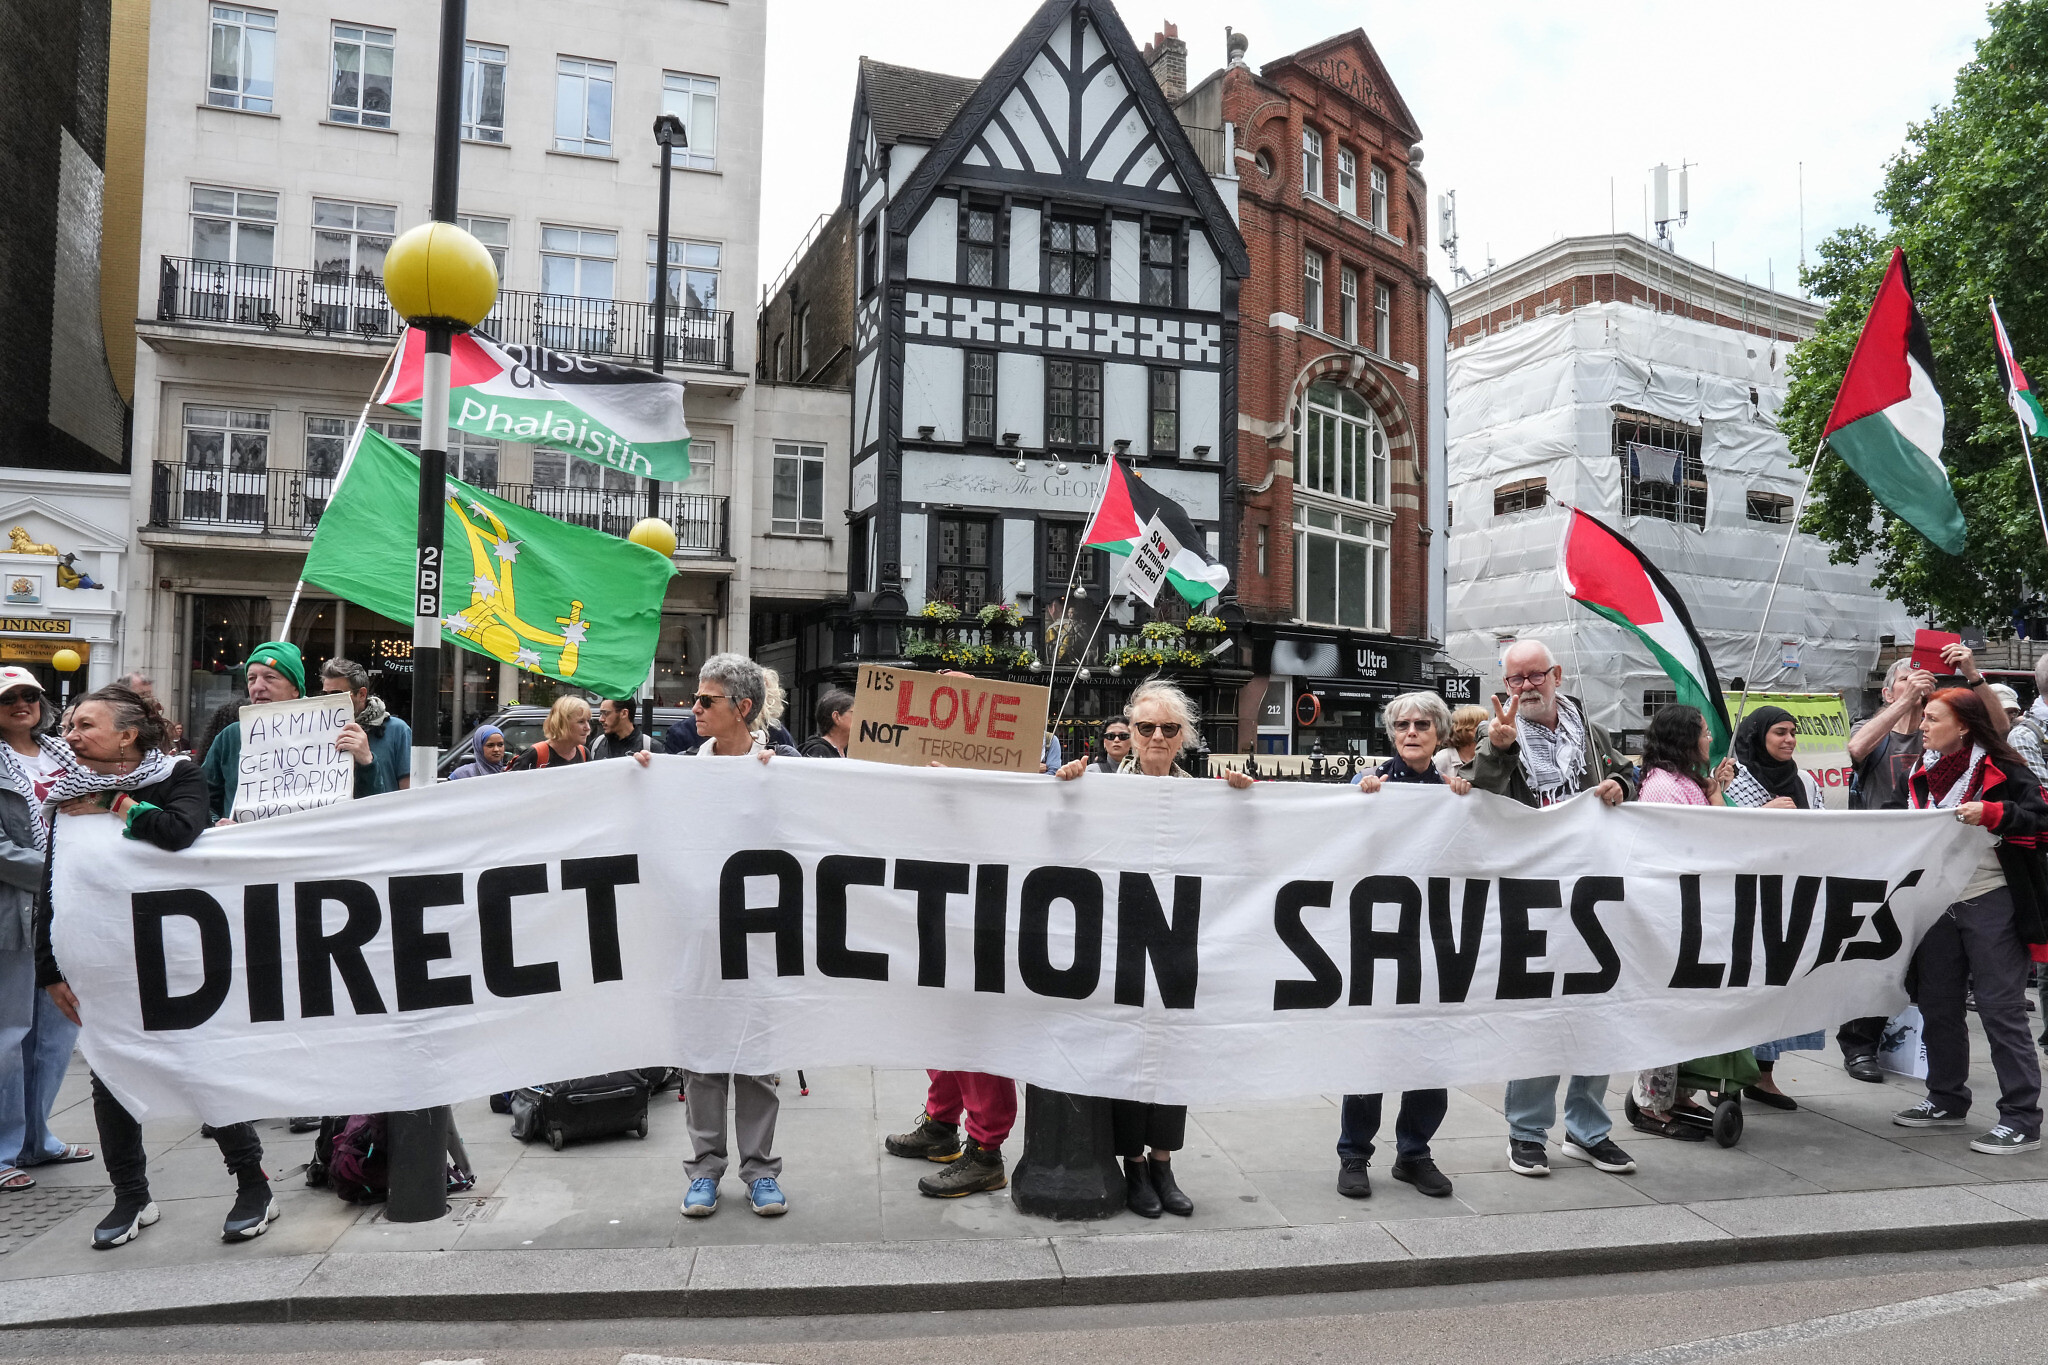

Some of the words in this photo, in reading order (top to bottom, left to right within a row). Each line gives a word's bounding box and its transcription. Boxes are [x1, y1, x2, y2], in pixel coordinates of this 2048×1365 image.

[457, 397, 652, 475] Phalaistín
[1005, 475, 1037, 495] The
[1044, 476, 1105, 498] GEOR
[1141, 543, 1165, 574] Arming
[1151, 530, 1170, 560] Stop
[1135, 554, 1160, 583] Israel
[1357, 649, 1388, 668] Ultra
[1361, 668, 1377, 677] vuse
[1007, 673, 1038, 683] PUBLIC
[1445, 679, 1471, 692] BK
[896, 680, 1021, 741] LOVE
[1267, 704, 1281, 715] 212
[249, 708, 351, 744] ARMING
[859, 719, 909, 747] NOT
[240, 742, 350, 775] GENOCIDE
[918, 737, 1022, 767] TERRORISM
[240, 768, 349, 802] TERRORISM
[131, 854, 640, 1031] DIRECT
[719, 849, 1202, 1009] ACTION
[1273, 875, 1625, 1011] SAVES
[1668, 868, 1925, 988] LIVES
